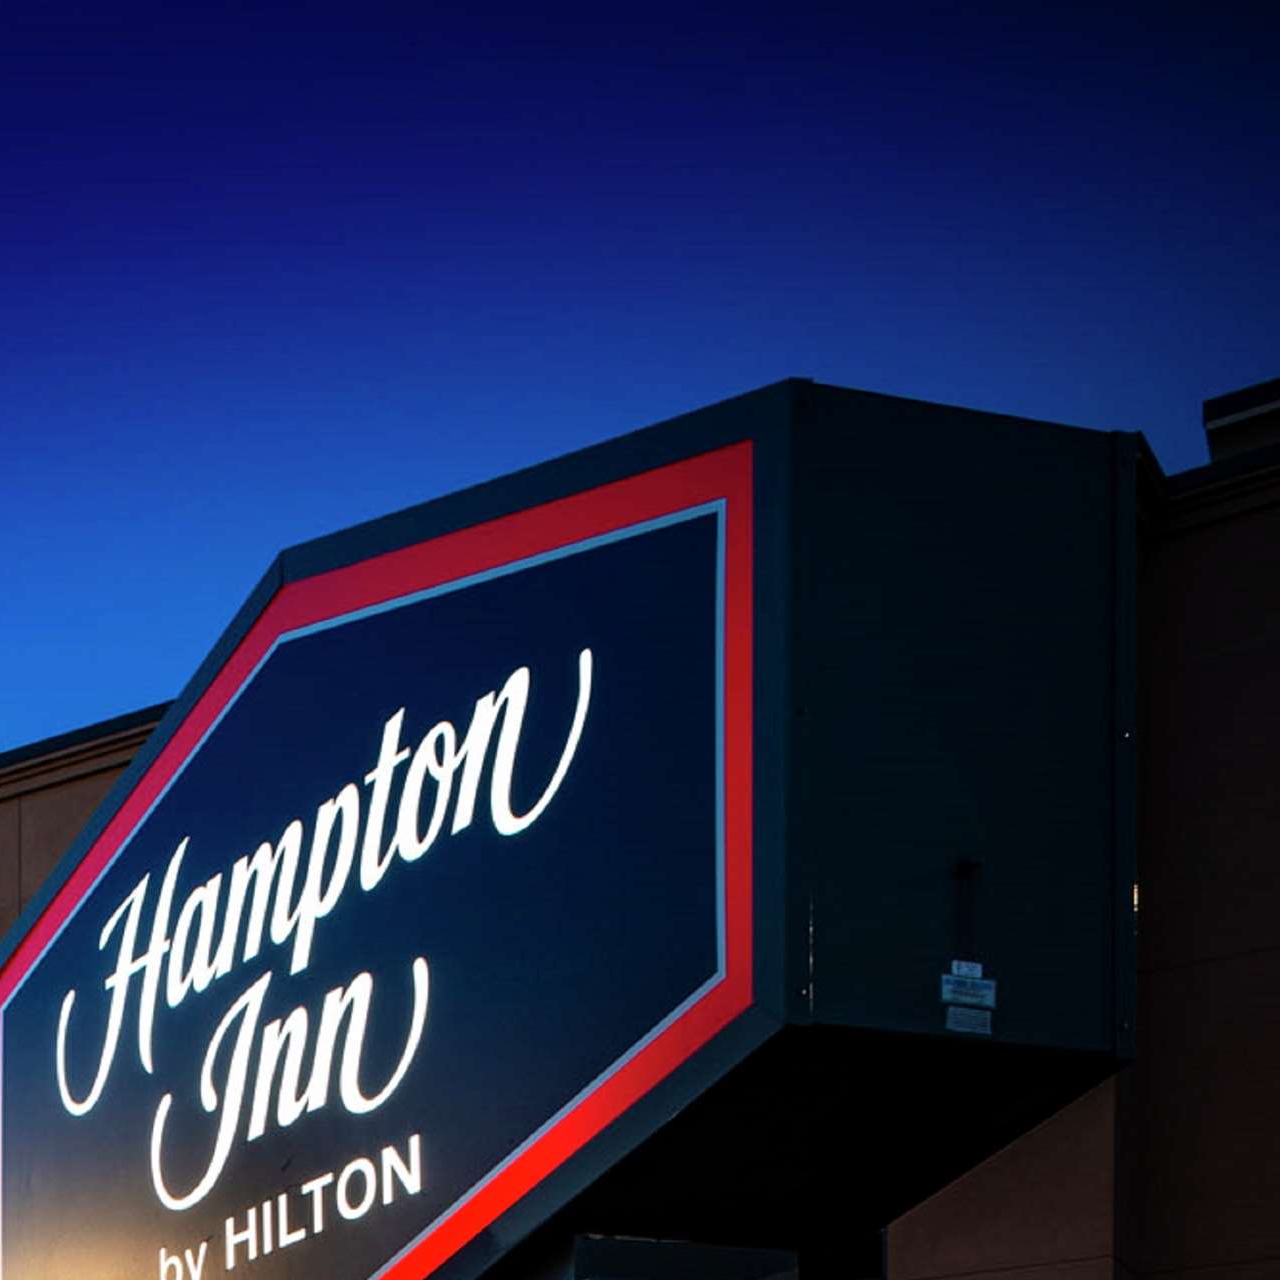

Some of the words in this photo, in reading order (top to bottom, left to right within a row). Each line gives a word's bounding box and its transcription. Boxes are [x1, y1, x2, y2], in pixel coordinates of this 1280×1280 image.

[56, 648, 592, 1116] Hampton
[150, 957, 429, 1211] Inn
[225, 1134, 422, 1270] HILTON
